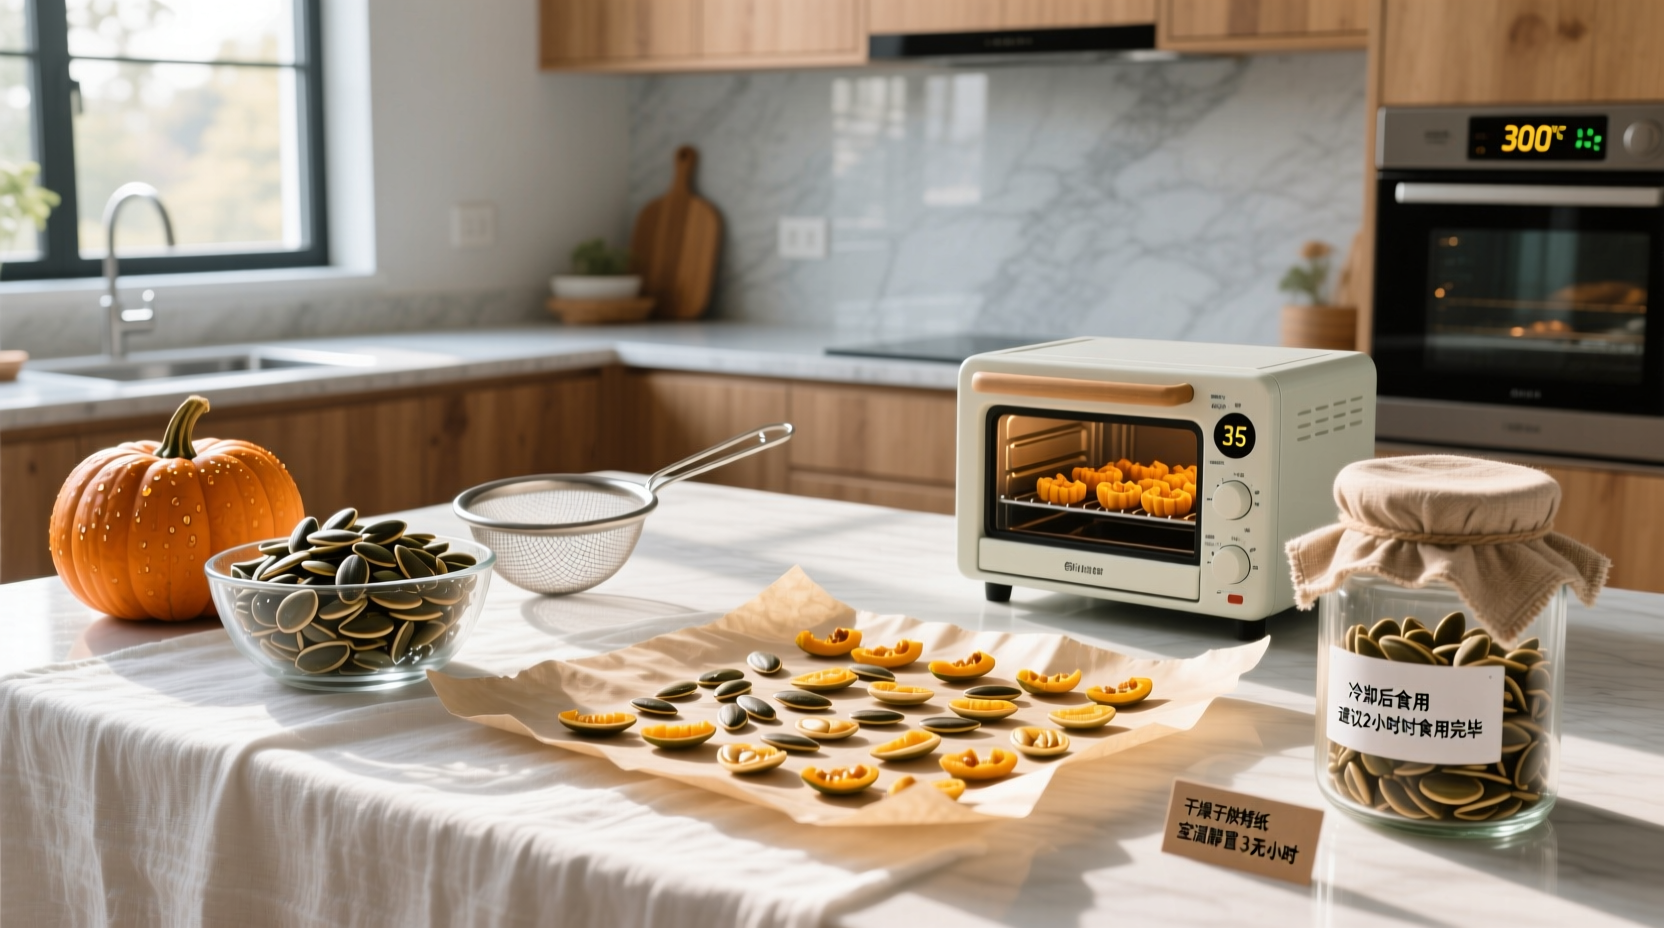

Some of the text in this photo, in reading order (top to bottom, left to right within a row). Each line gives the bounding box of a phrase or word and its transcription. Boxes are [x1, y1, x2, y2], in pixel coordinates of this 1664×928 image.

[1222, 424, 1247, 448] 35
[1348, 682, 1430, 712] 冷却后食用
